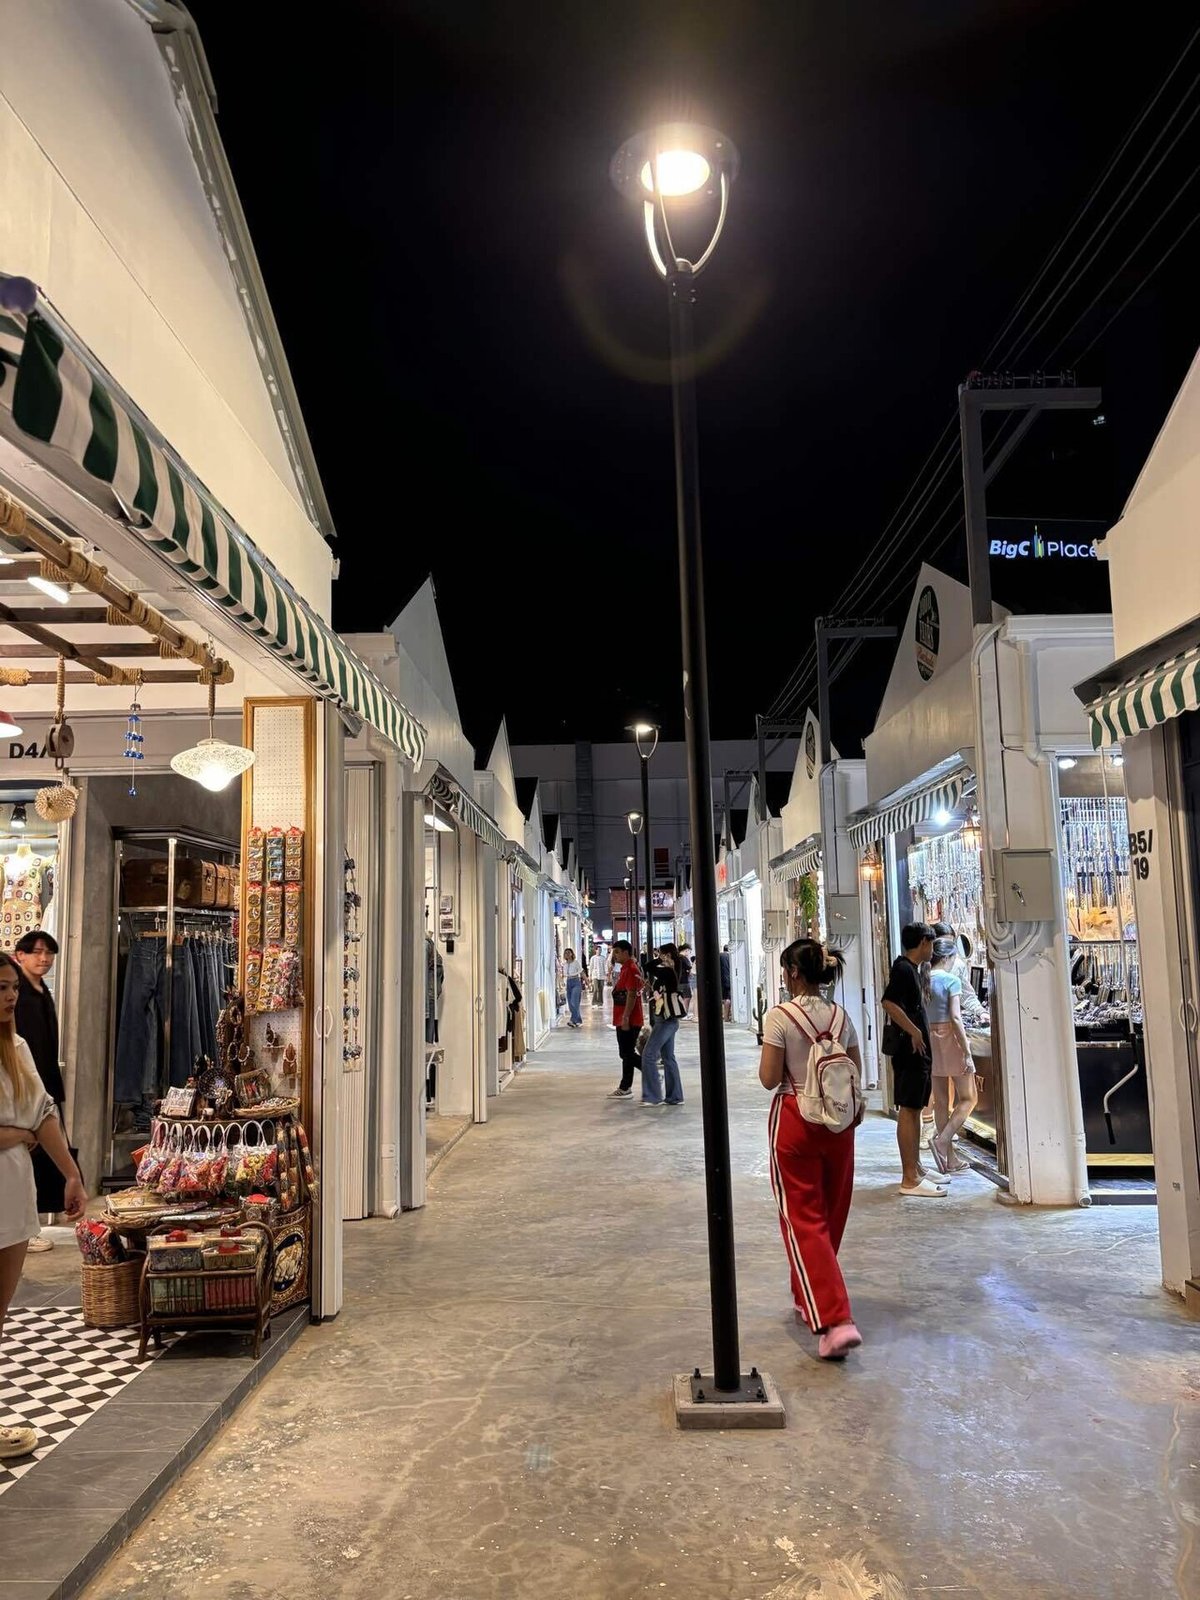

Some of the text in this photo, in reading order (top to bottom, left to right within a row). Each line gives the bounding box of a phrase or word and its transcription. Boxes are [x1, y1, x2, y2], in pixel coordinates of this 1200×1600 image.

[1047, 541, 1097, 557] Place
[1128, 829, 1153, 856] B5/
[1133, 856, 1150, 881] 19
